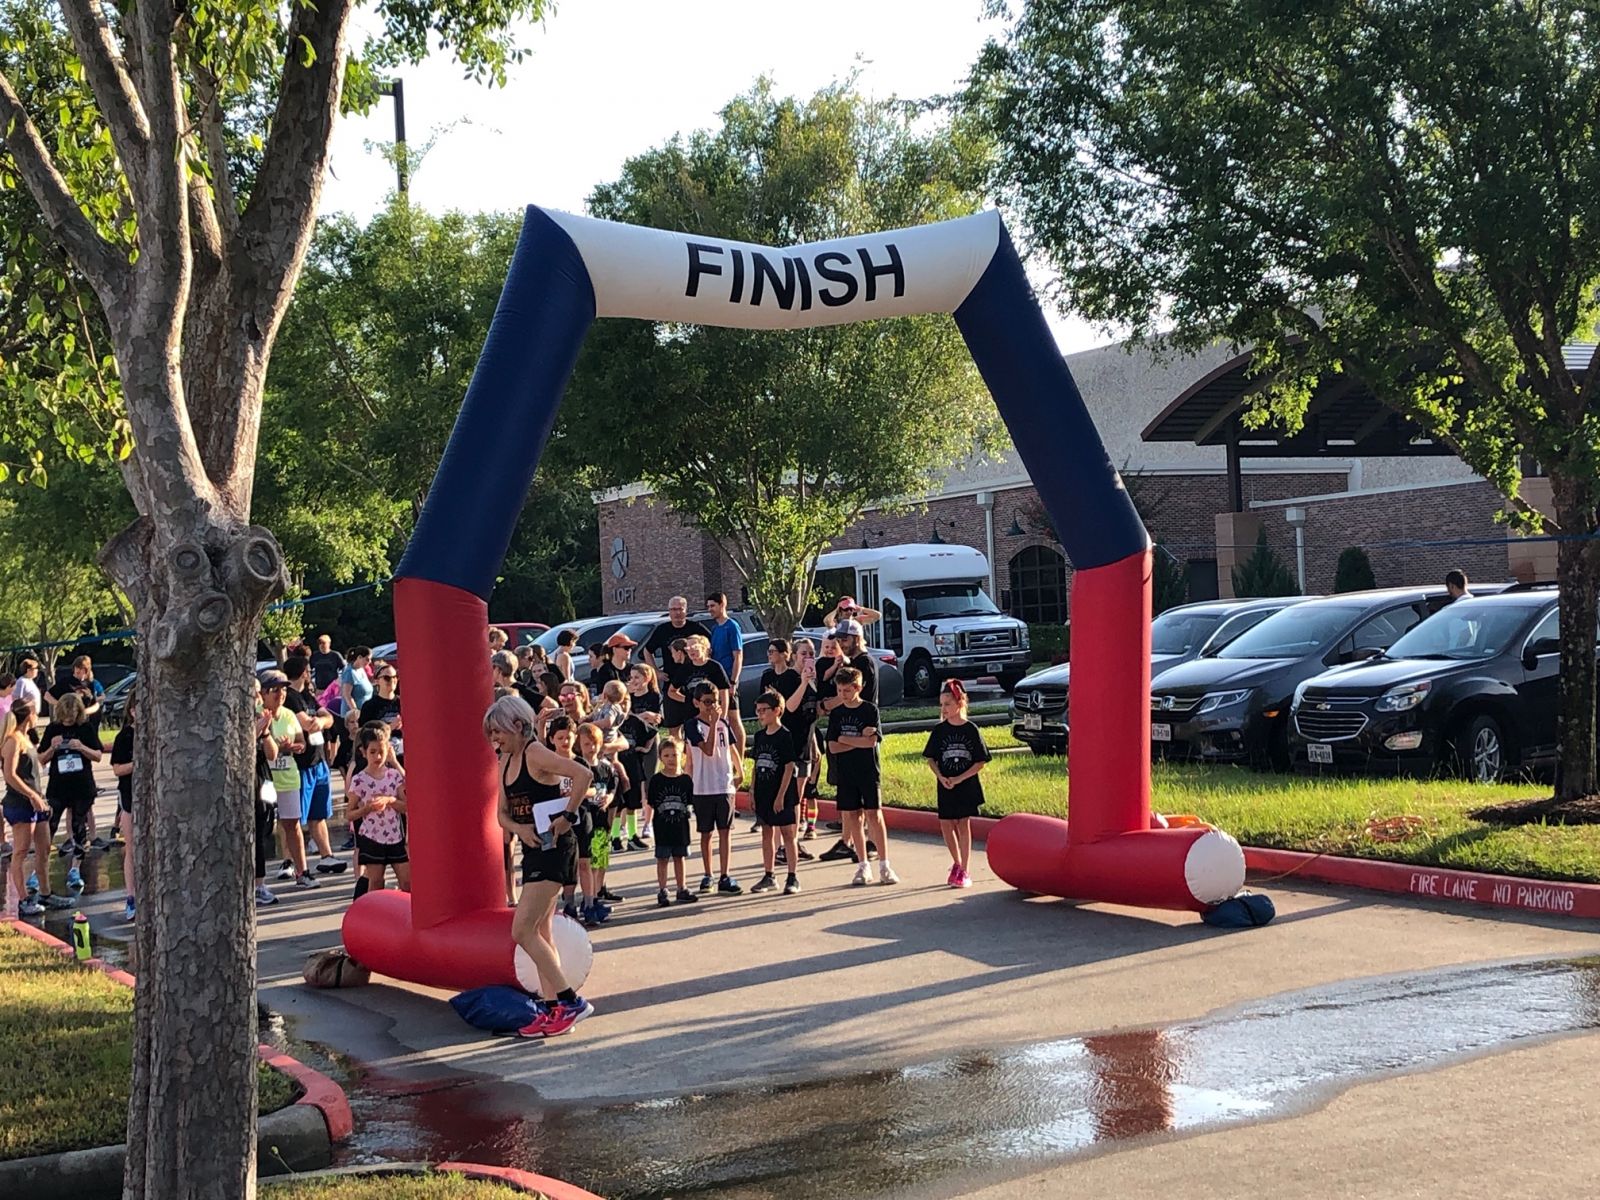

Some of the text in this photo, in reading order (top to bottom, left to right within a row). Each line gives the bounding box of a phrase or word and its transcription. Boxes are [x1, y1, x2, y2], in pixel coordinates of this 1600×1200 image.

[685, 242, 905, 311] FINISH
[613, 586, 636, 605] LOFT
[275, 758, 287, 769] 133
[1410, 873, 1574, 912] FIRE LANE NO PARKING
